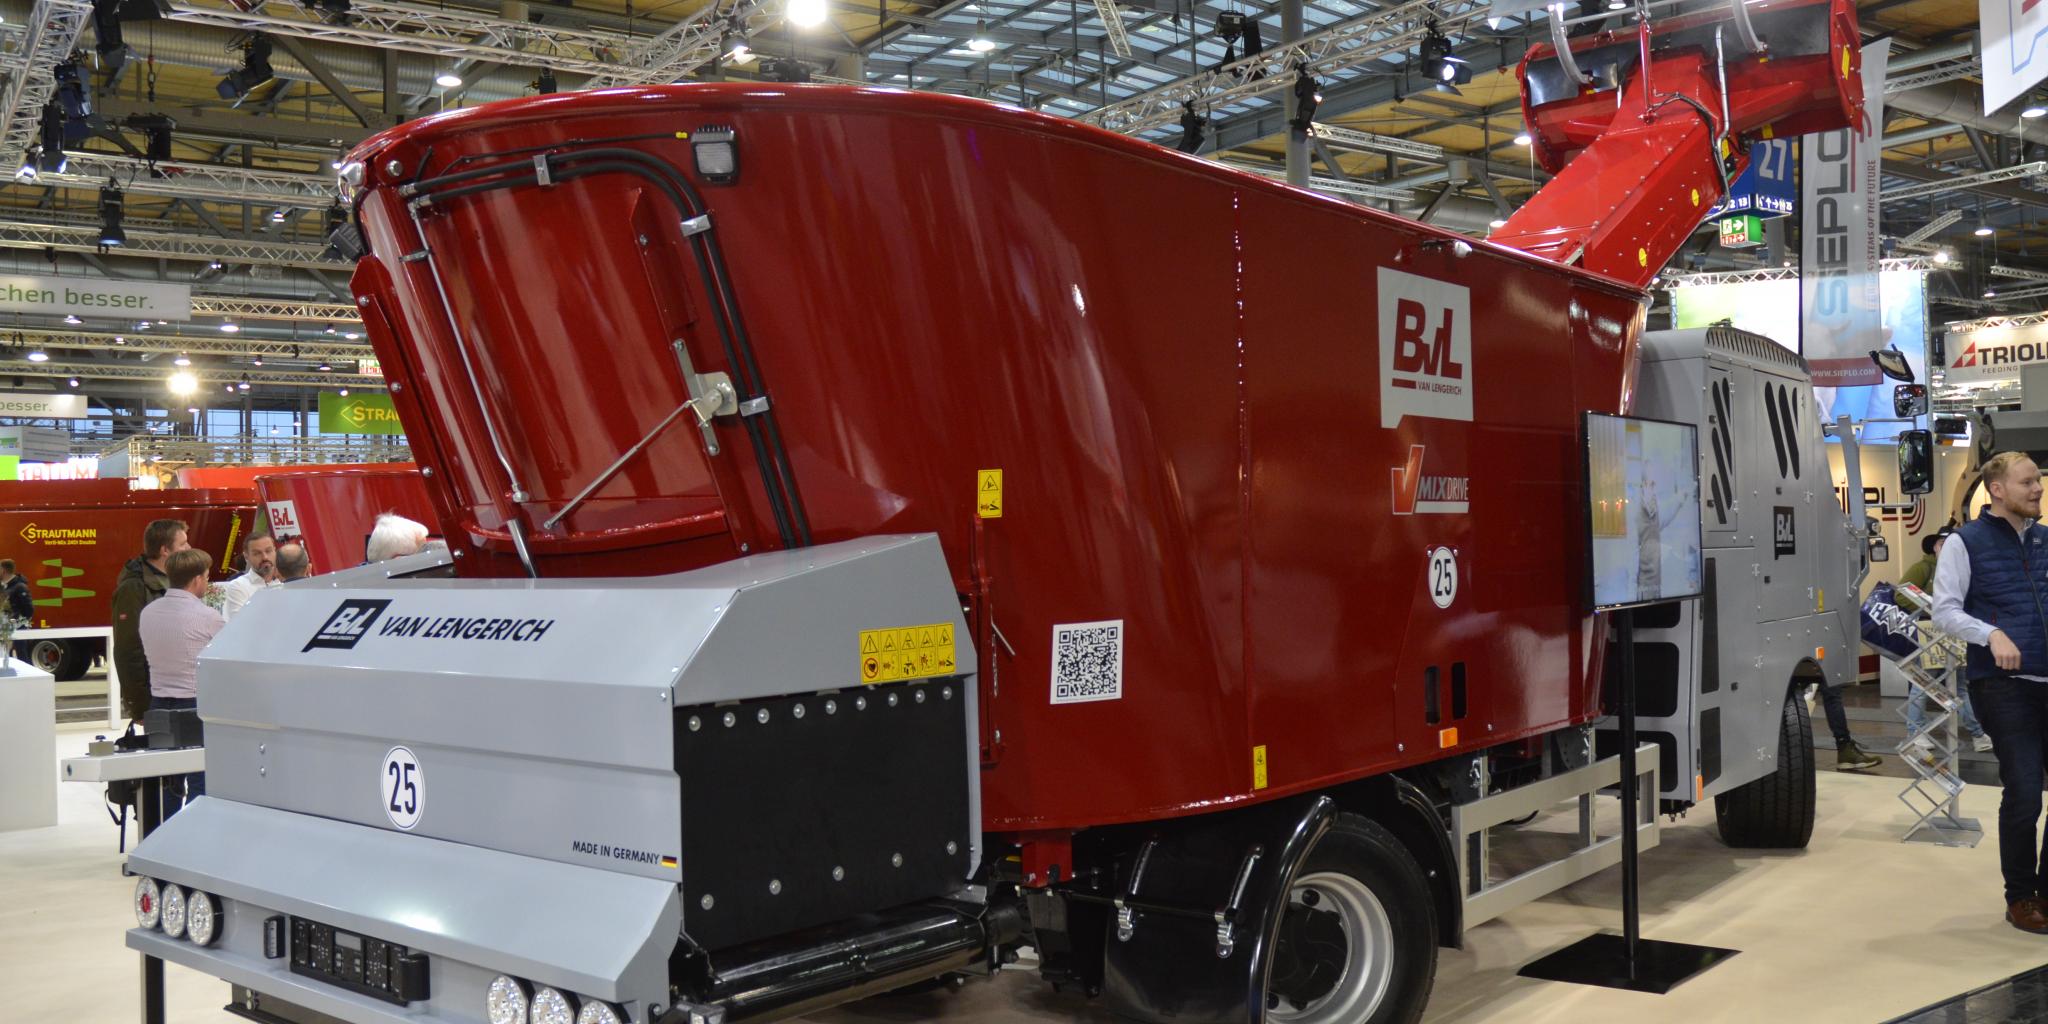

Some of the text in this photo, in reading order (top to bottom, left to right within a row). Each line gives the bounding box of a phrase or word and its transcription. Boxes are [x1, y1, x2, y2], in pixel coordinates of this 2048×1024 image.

[1759, 138, 1787, 181] 27
[1867, 159, 1877, 194] FUTURE
[1867, 197, 1876, 214] THE
[1867, 217, 1876, 228] OF
[1866, 231, 1876, 271] SYSTEMS
[65, 288, 154, 309] besser.
[1393, 298, 1463, 379] BvL
[1978, 341, 2048, 366] TRIOL
[1982, 365, 2018, 374] FEEDING
[1418, 381, 1462, 395] VAN LENGERICH
[1434, 558, 1452, 597] 25
[378, 616, 555, 642] VAN LENGERICH
[389, 760, 417, 815] 25
[572, 840, 660, 865] MADE IN GERMANY
